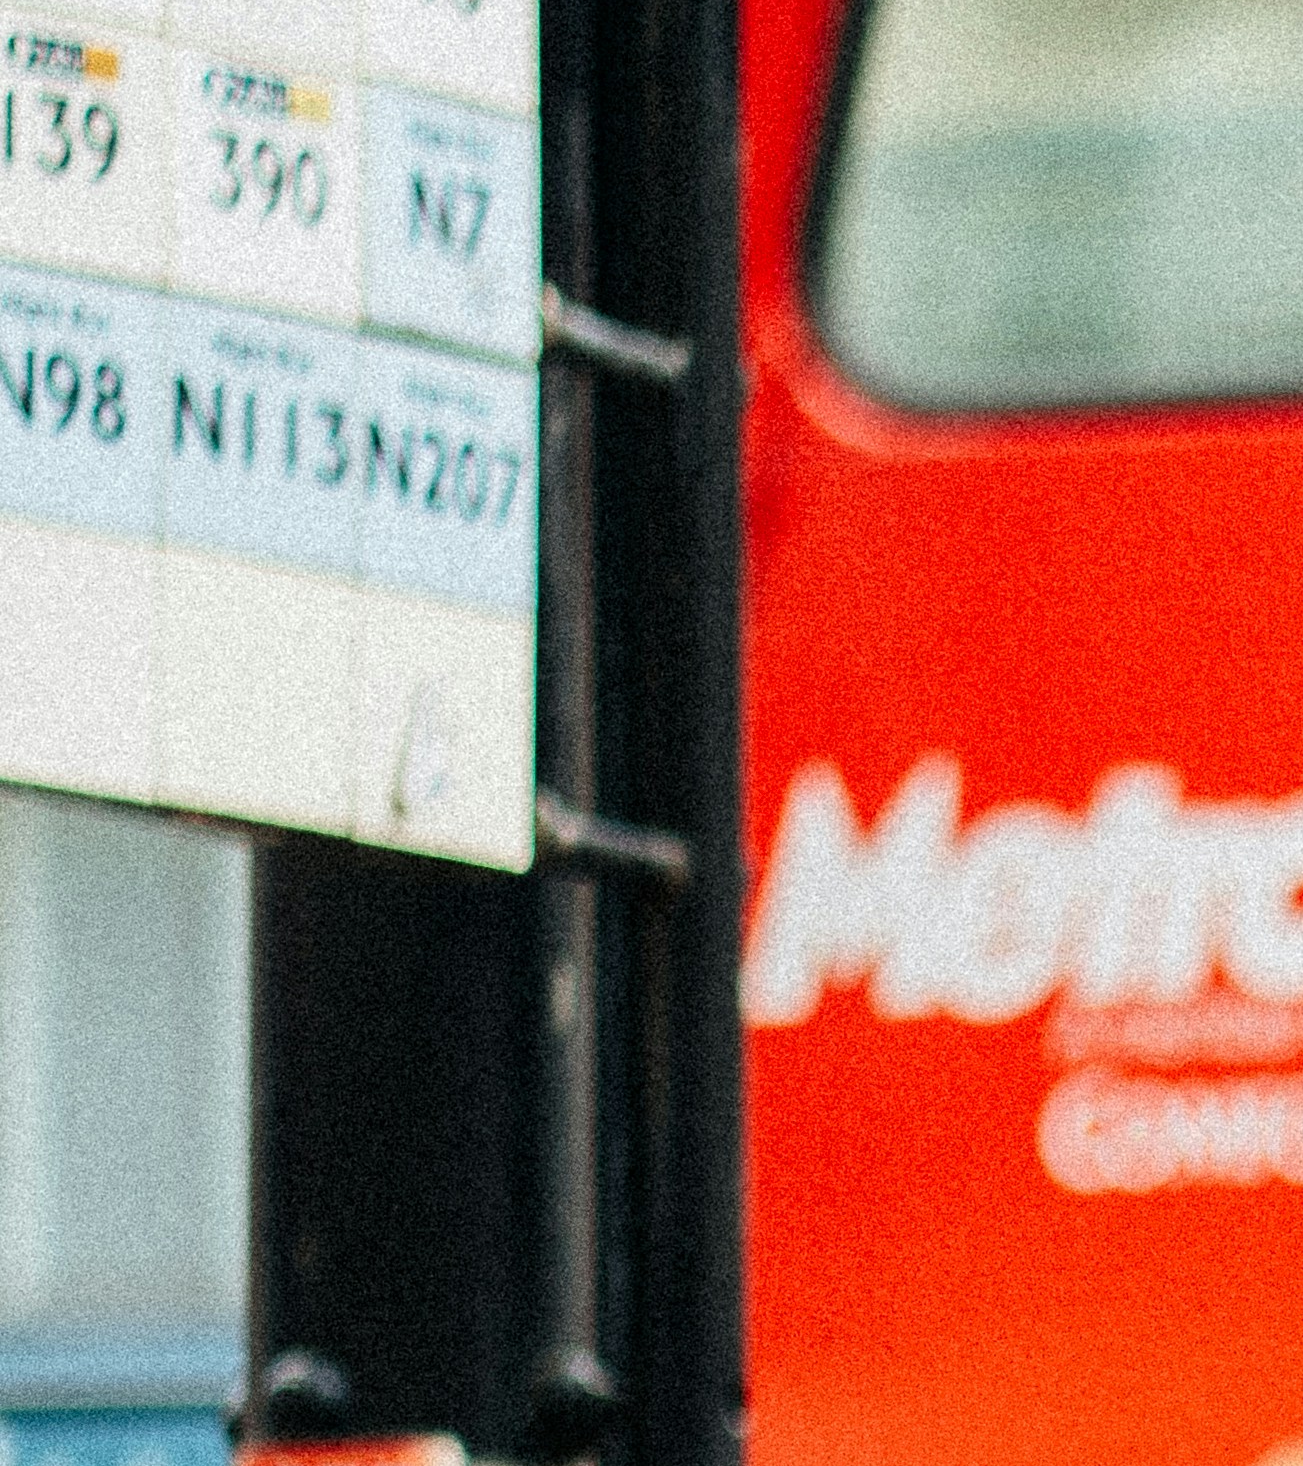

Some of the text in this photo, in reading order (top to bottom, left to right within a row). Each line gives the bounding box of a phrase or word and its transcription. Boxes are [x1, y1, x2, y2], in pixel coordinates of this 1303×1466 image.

[2, 89, 120, 186] 139
[208, 125, 329, 230] 390
[408, 166, 493, 267] N7
[0, 344, 127, 445] N98
[172, 370, 348, 489] N113
[366, 416, 524, 529] N207
